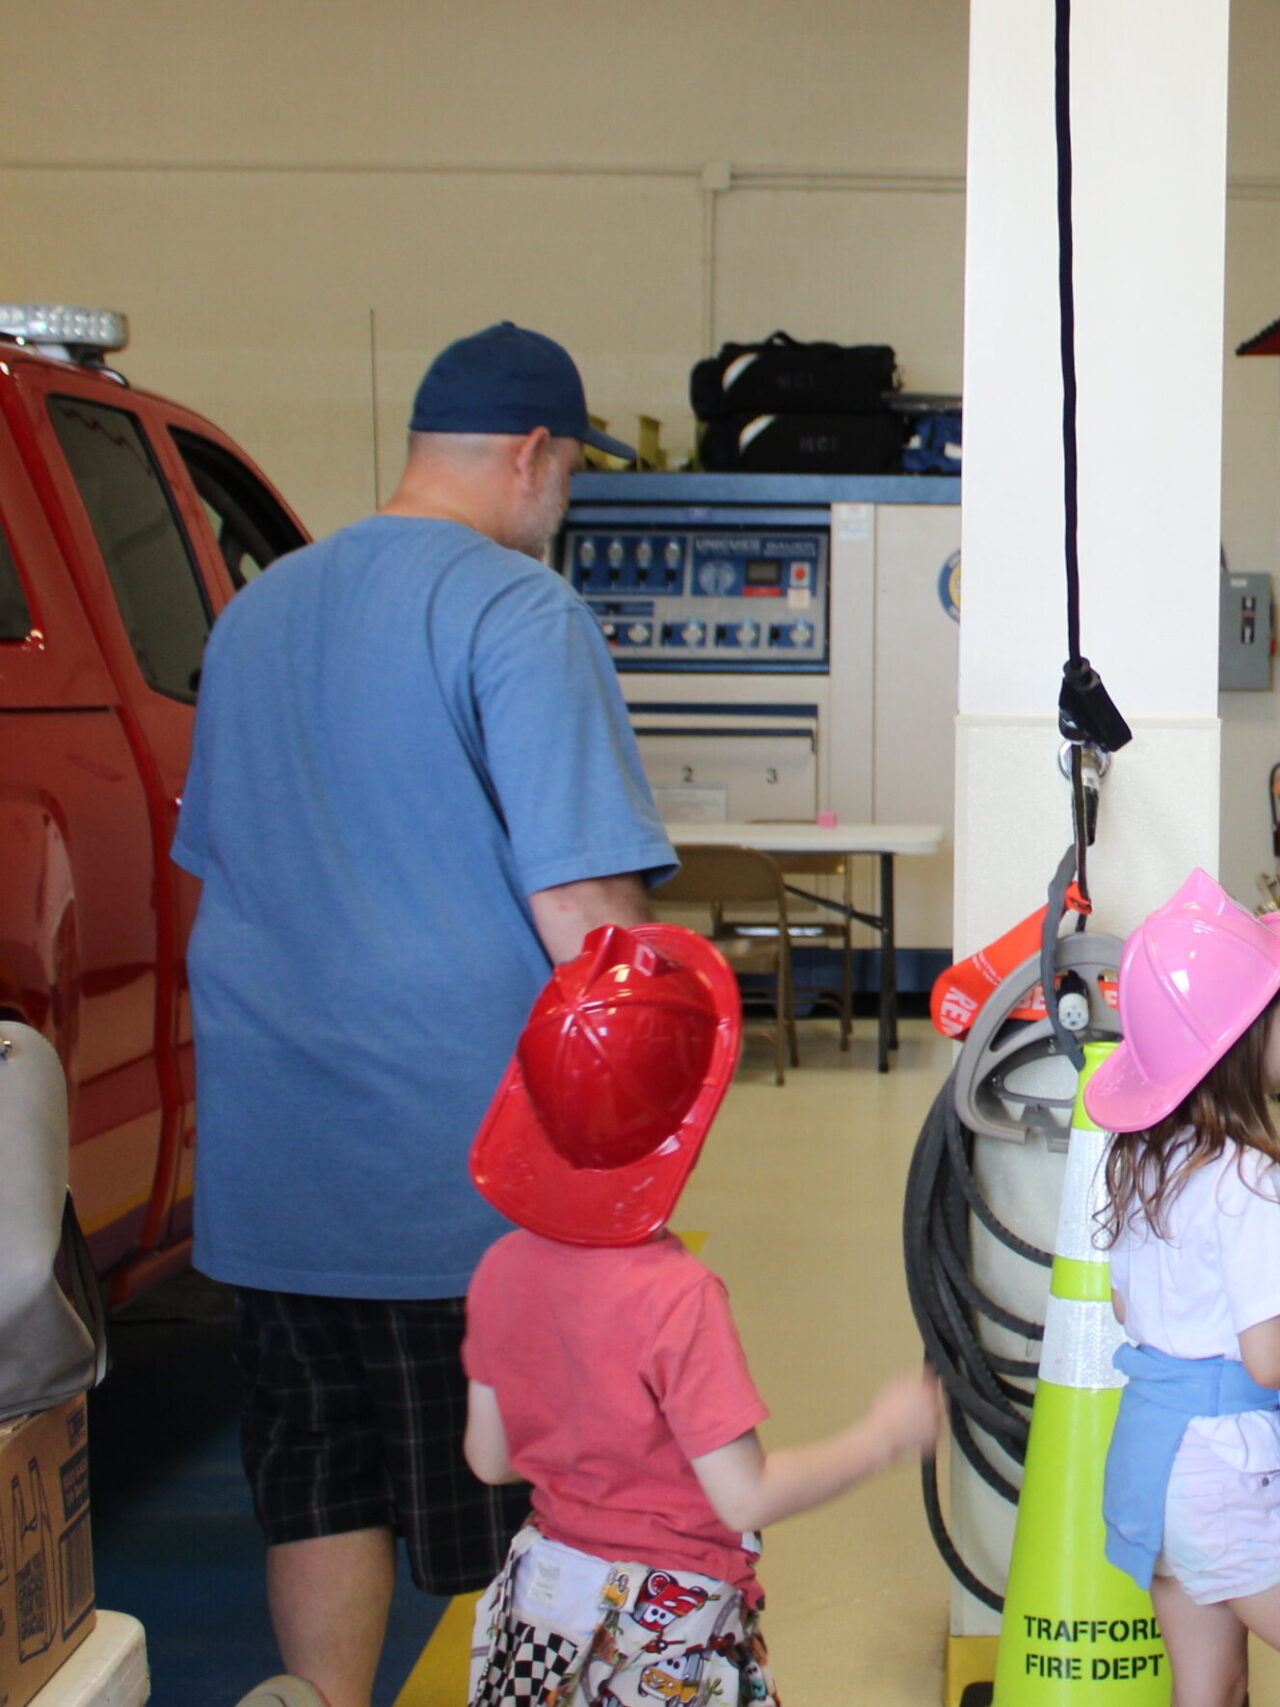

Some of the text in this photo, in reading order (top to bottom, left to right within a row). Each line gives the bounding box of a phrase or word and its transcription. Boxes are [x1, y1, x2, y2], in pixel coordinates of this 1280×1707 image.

[682, 765, 694, 783] 2
[766, 766, 779, 785] 3
[1025, 1653, 1164, 1680] FIRE DEPT
